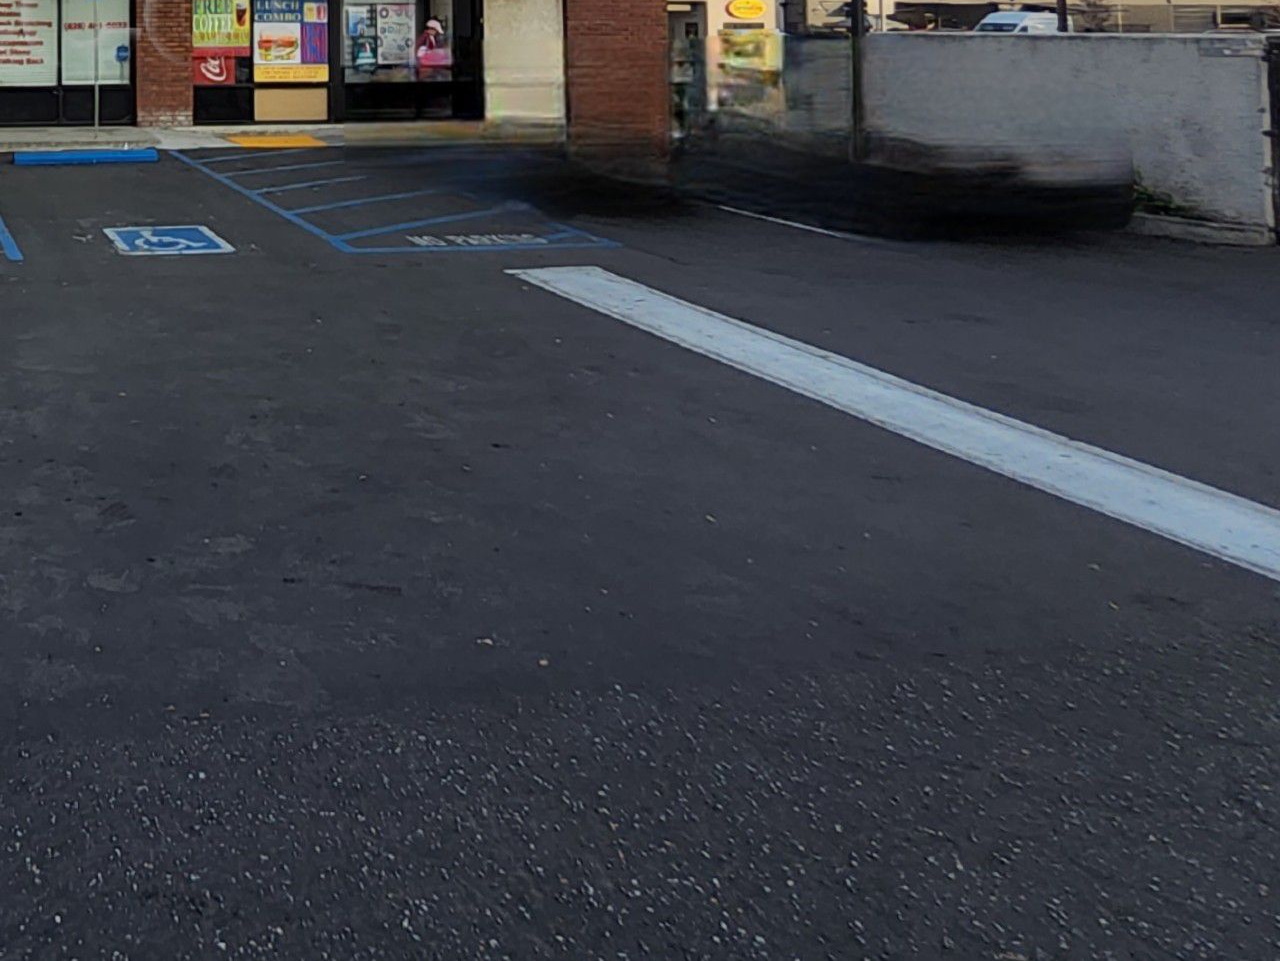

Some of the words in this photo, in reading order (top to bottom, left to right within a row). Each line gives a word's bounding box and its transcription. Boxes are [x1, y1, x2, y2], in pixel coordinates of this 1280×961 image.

[256, 0, 300, 11] LUNCH
[193, 14, 234, 32] COFFEE
[254, 12, 302, 23] COMBO
[405, 235, 448, 246] NO
[444, 233, 549, 246] PARKING
